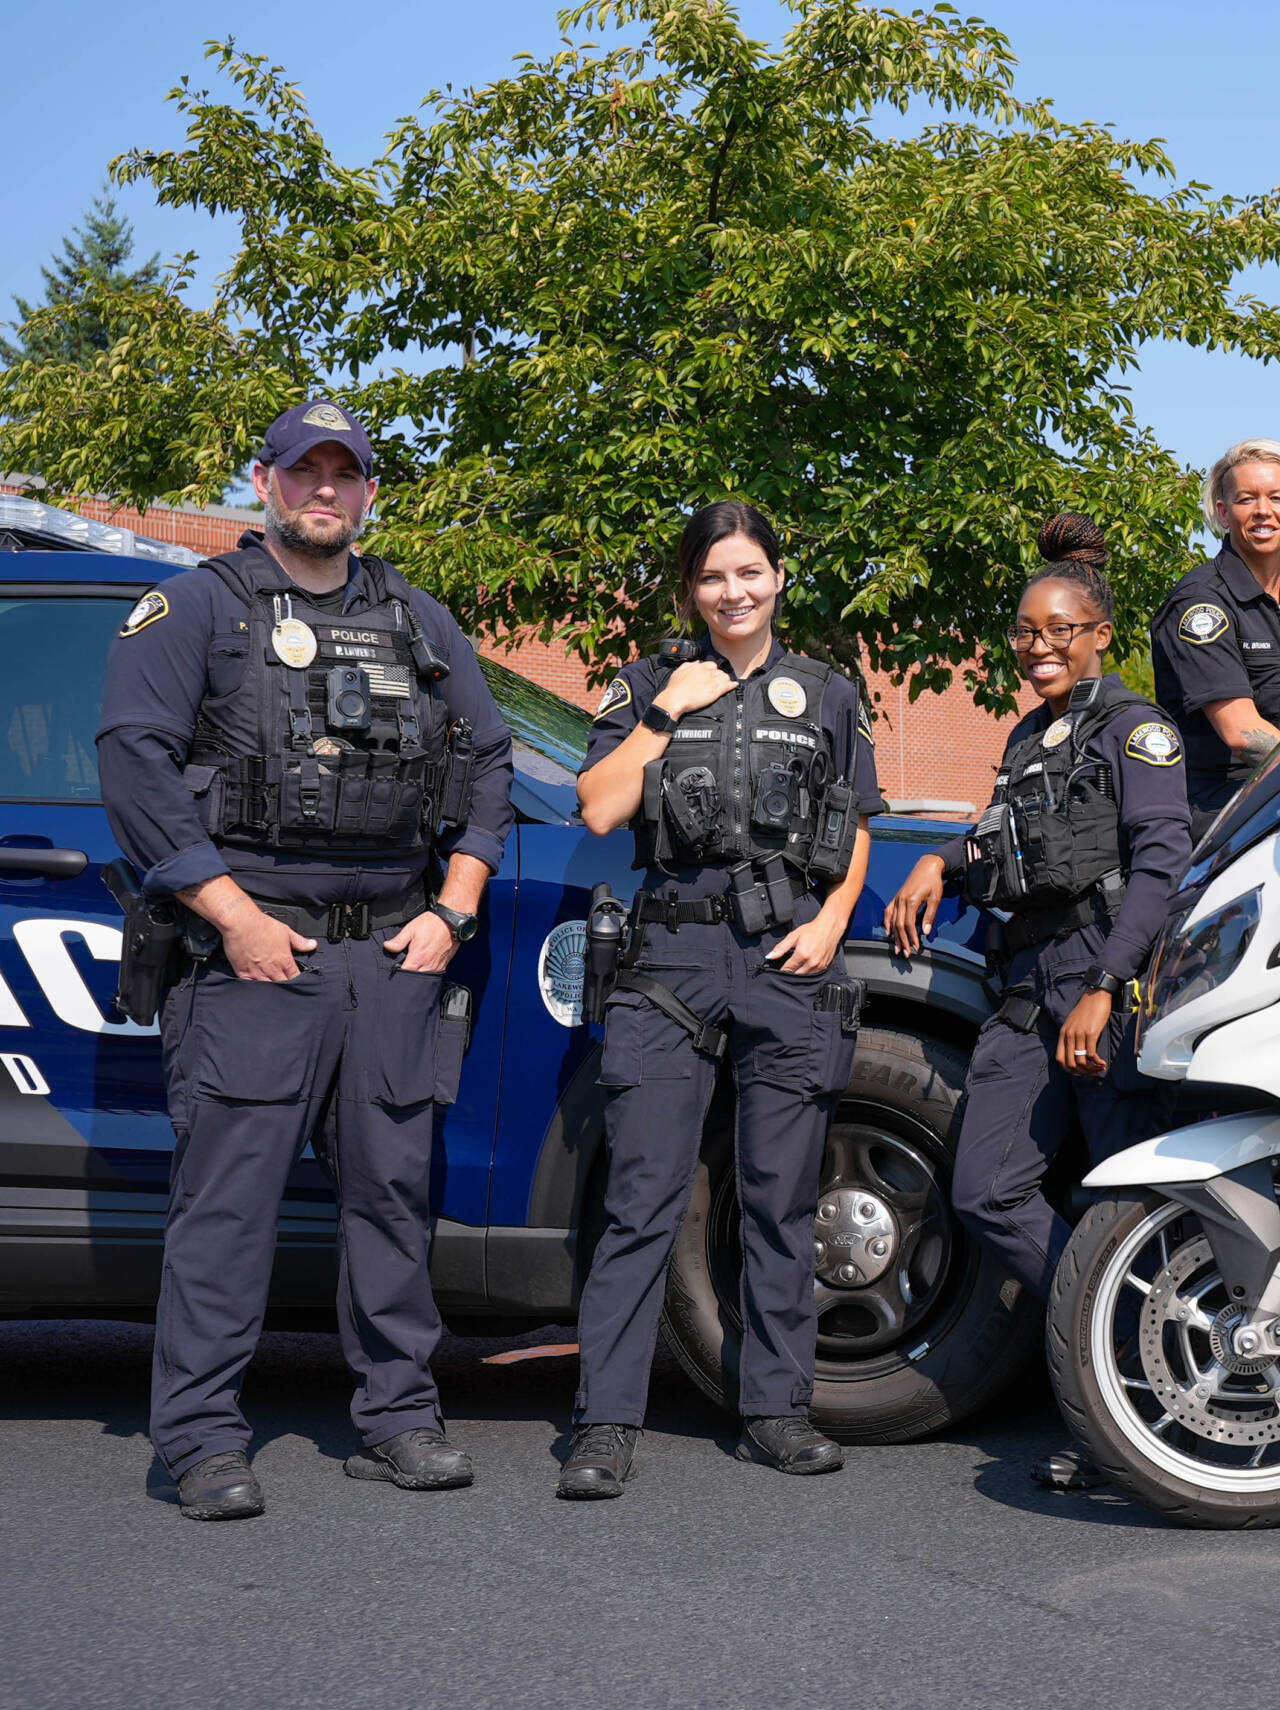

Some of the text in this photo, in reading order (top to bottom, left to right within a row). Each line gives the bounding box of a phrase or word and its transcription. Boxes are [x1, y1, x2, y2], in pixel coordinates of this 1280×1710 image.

[330, 629, 379, 644] POLICE
[756, 729, 816, 749] POLICE
[548, 926, 574, 947] POLICE
